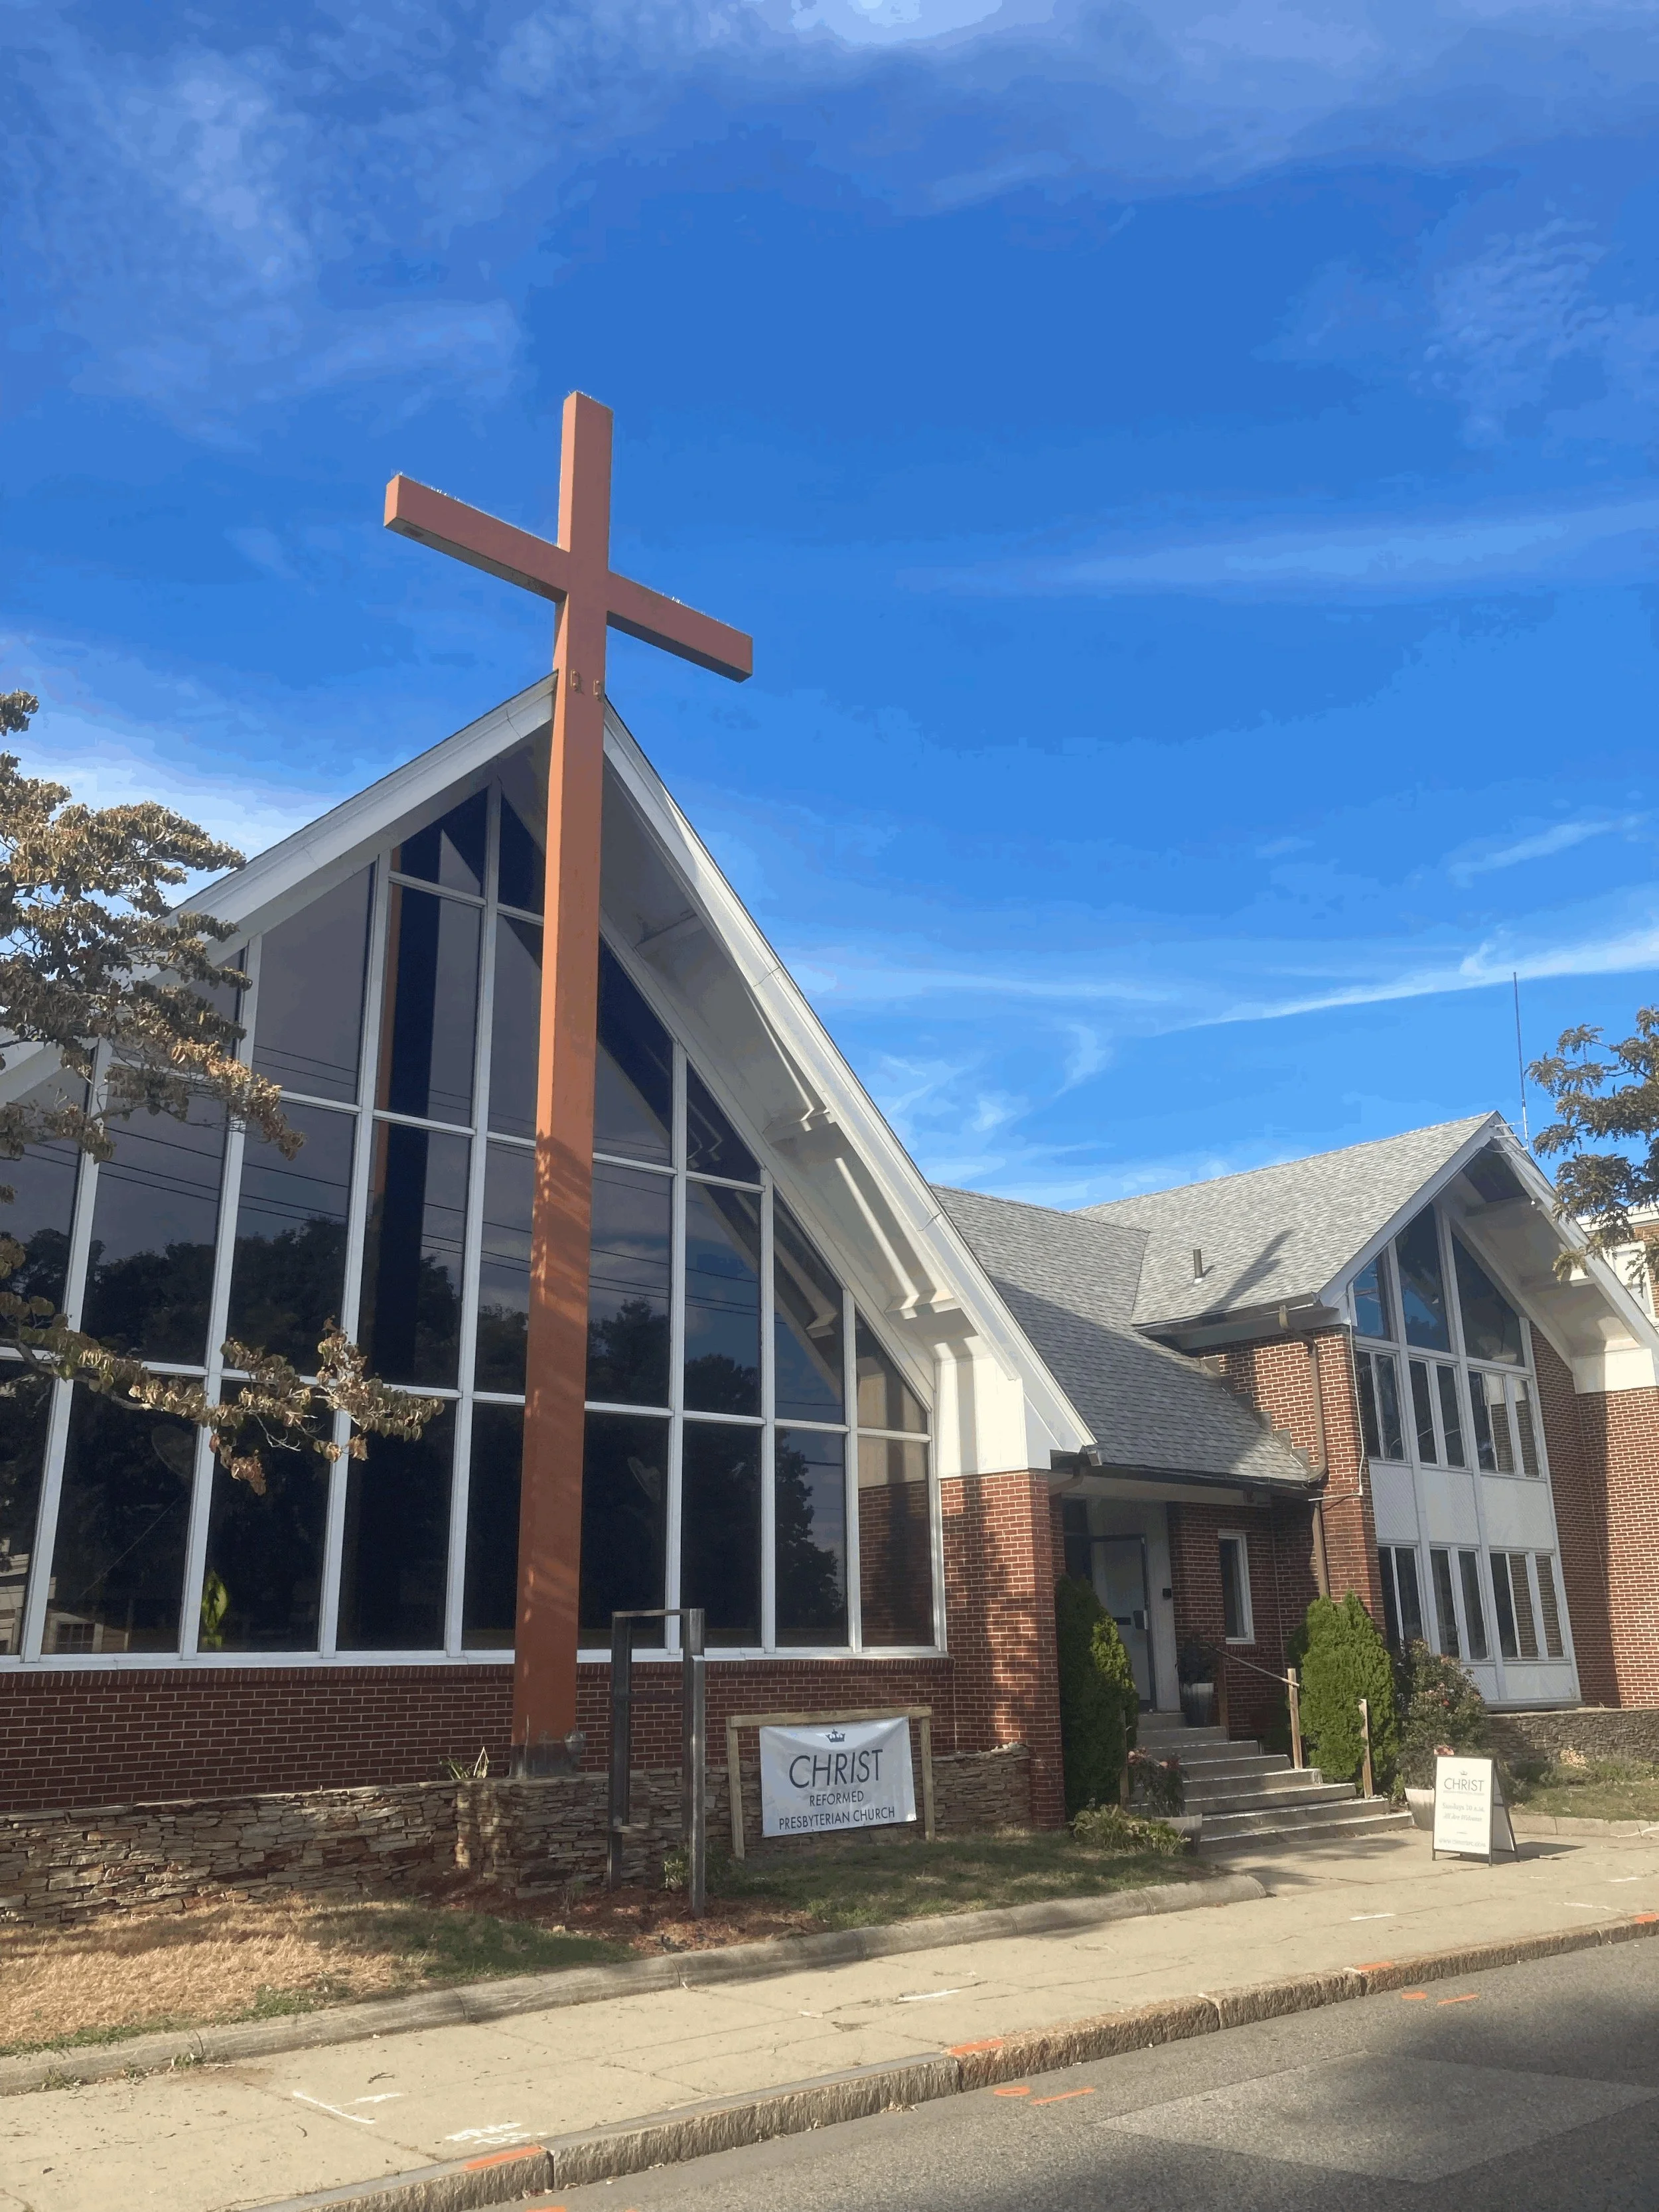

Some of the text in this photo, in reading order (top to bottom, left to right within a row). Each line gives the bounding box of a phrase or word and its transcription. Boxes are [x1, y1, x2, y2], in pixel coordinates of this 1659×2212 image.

[789, 1749, 883, 1789] CHRIST
[1444, 1778, 1484, 1792] CHRIST
[810, 1791, 864, 1806] REFORMED
[1442, 1802, 1465, 1811] Sundays
[779, 1806, 895, 1830] PRESBYTERIAN CHURCH
